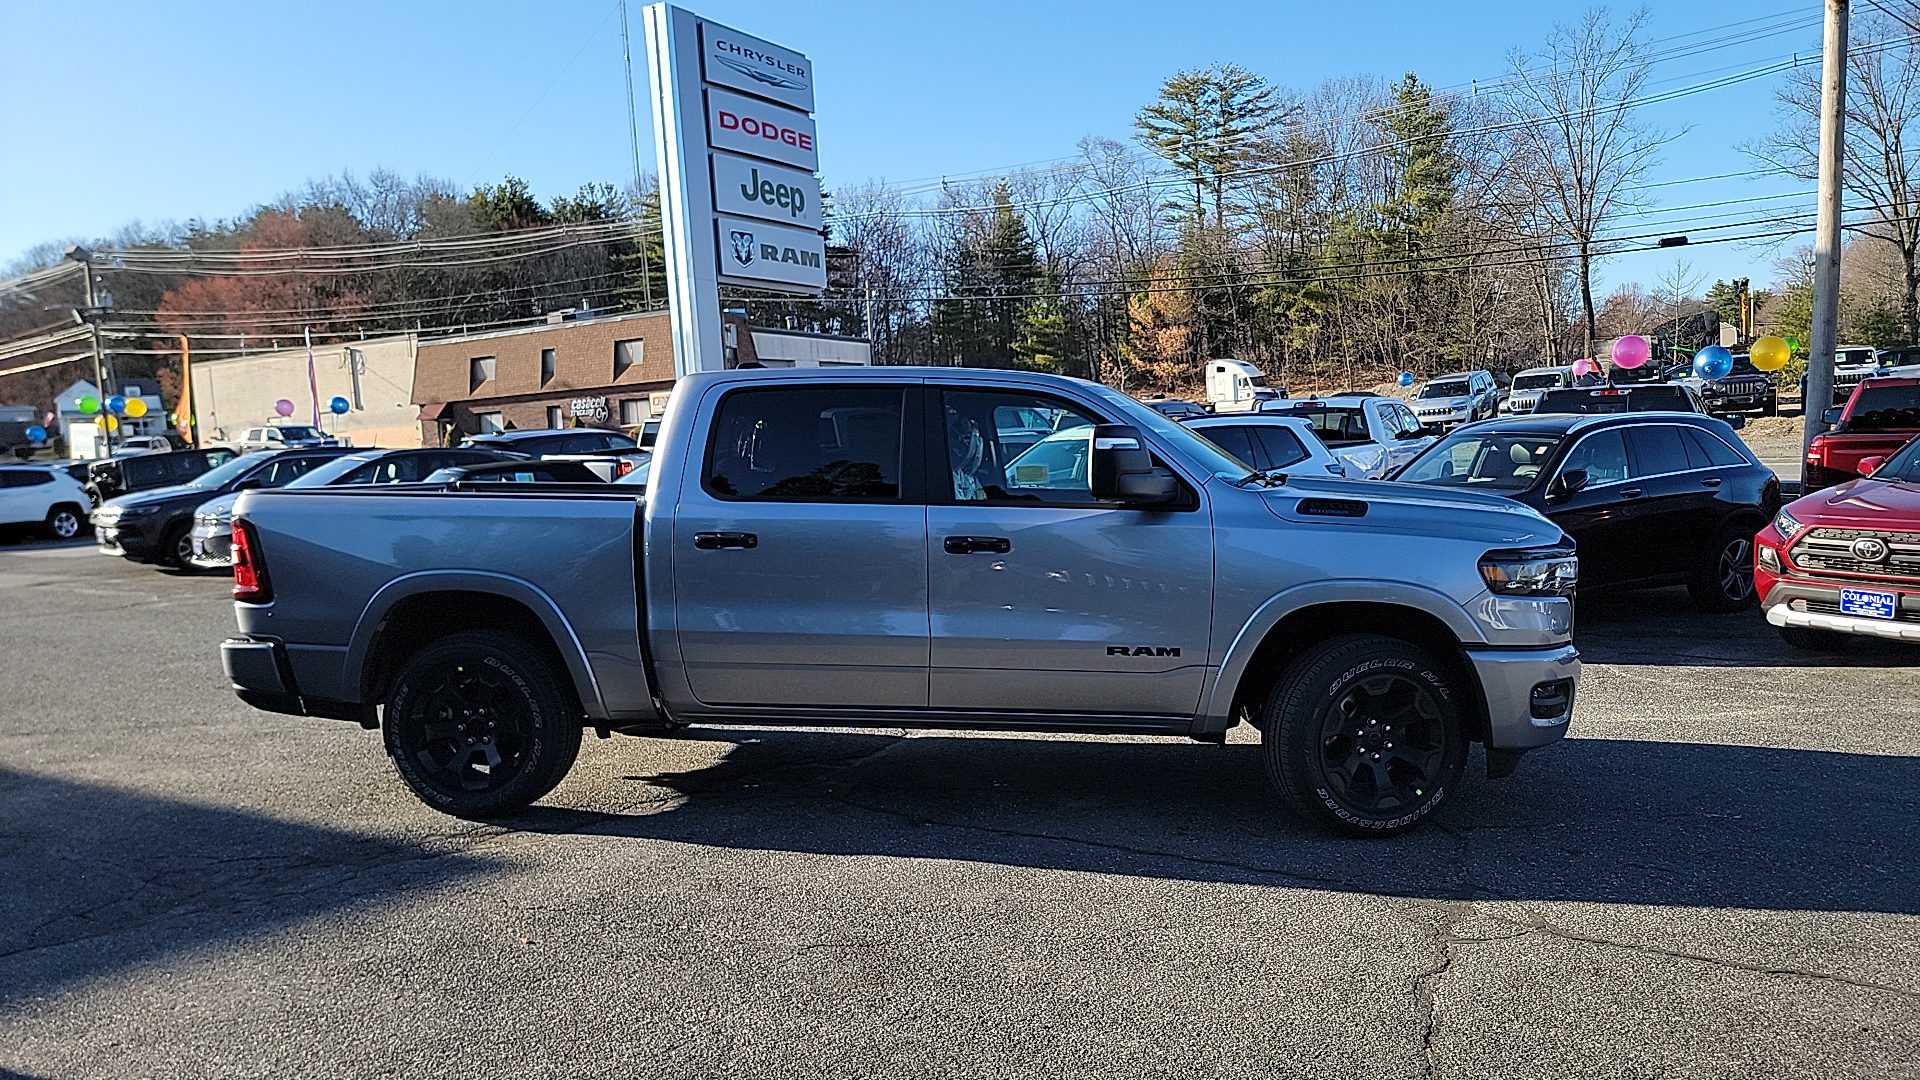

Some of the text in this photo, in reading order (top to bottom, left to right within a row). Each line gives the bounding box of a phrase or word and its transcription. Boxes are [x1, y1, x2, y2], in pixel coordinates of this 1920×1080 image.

[716, 40, 806, 79] CHRYSLER
[719, 110, 813, 151] DODGE
[740, 168, 805, 217] Jeep
[760, 243, 821, 269] RAM
[1842, 592, 1893, 605] COLONIAL
[1106, 646, 1181, 658] RAM
[1328, 658, 1415, 696] DUELER
